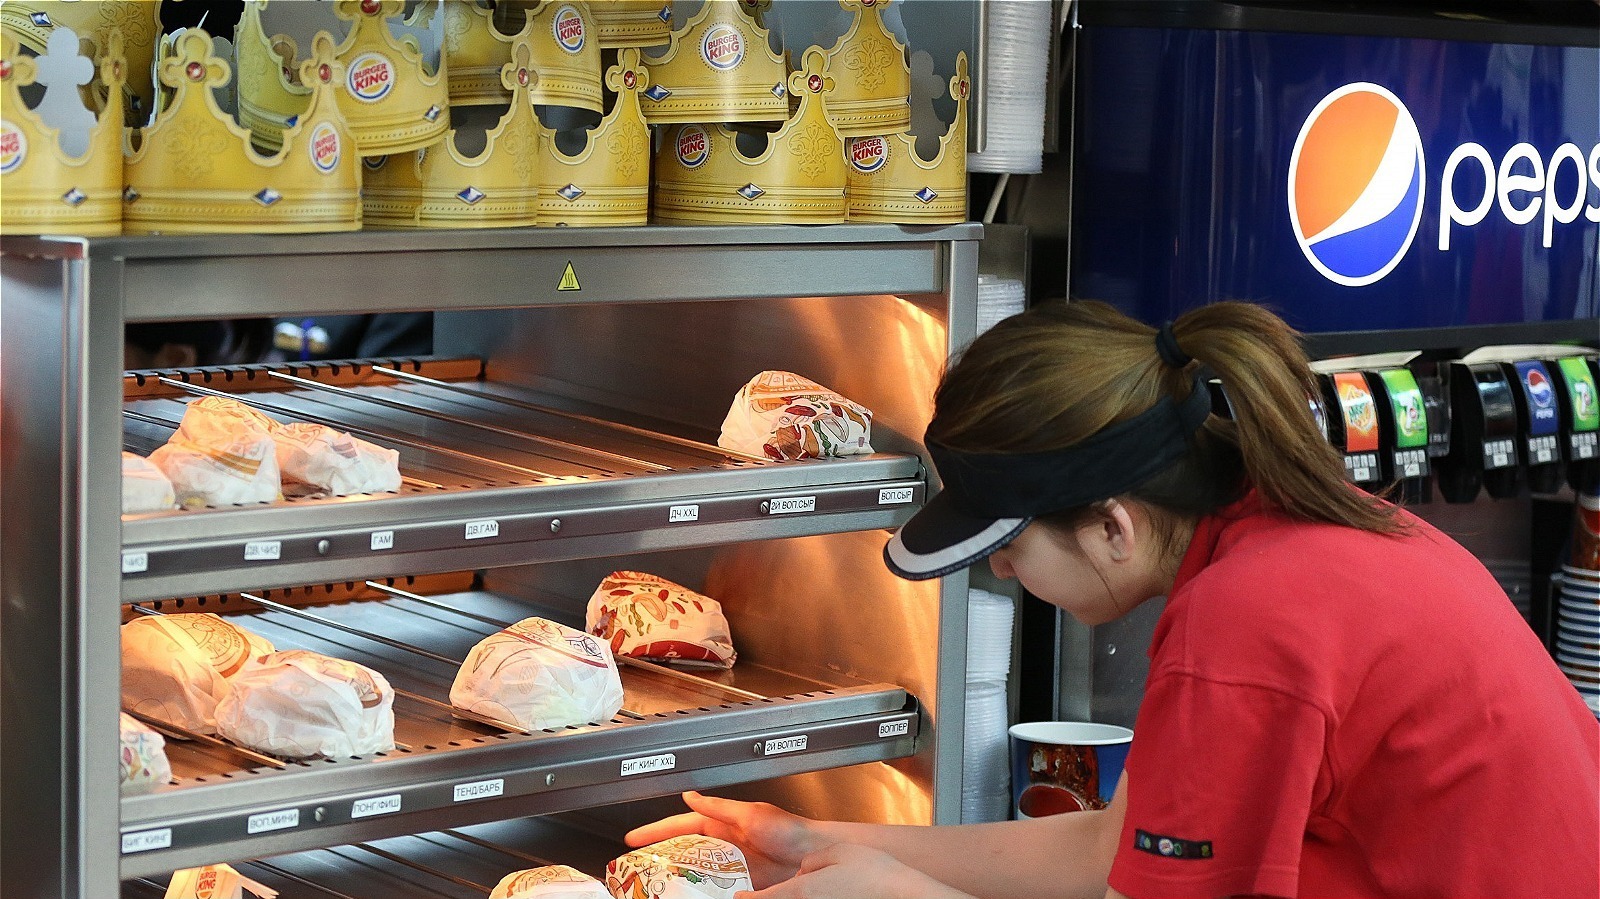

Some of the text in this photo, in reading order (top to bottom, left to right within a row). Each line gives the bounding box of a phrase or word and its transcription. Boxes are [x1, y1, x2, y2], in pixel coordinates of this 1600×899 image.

[559, 17, 581, 30] BURGER
[560, 25, 583, 42] KING
[708, 34, 738, 50] BURGER
[709, 42, 740, 61] KING
[353, 63, 388, 81] BURGER
[355, 70, 389, 92] KING
[315, 133, 336, 148] BURGER
[679, 132, 704, 148] BURGER
[852, 138, 883, 152] BURGER
[316, 141, 337, 161] KING
[680, 141, 705, 157] KING
[853, 147, 884, 162] KING
[881, 488, 912, 500] ВОП.СЫР
[770, 497, 815, 510] 2Й ВОП.СЫР
[671, 506, 697, 518] ДЧ XXL
[373, 533, 392, 544] ГАМ
[880, 721, 908, 734] ВОППЕР
[766, 737, 807, 751] 2Й ВОППЕР
[622, 754, 674, 771] БИГ КИНГ XXL
[456, 782, 501, 797] ТЕНД/БАРБ
[198, 879, 216, 891] KING
